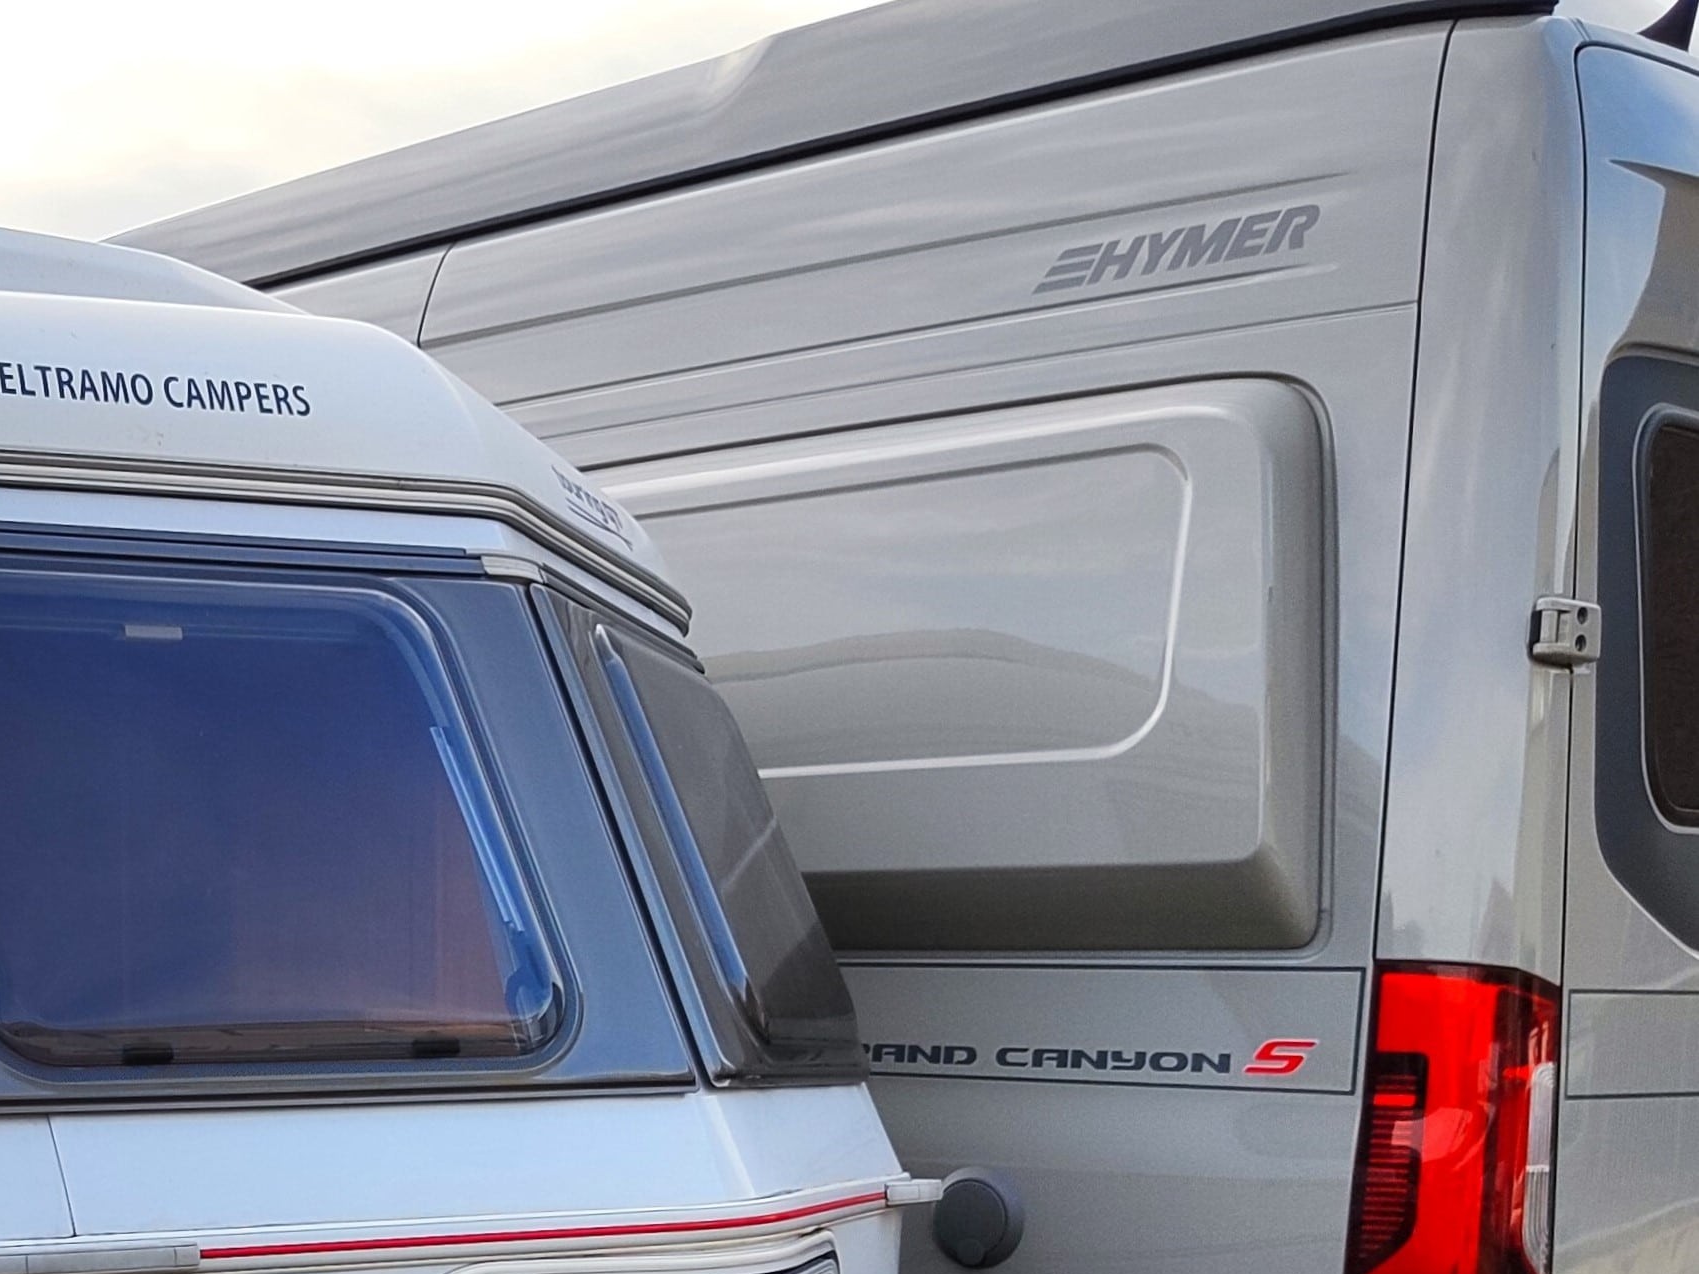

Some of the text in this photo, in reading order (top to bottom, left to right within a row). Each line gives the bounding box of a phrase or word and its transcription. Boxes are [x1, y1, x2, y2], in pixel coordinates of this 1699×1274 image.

[1085, 203, 1321, 287] HYMER
[162, 375, 312, 417] CAMPERS
[861, 1037, 1319, 1075] AND CANYON S
